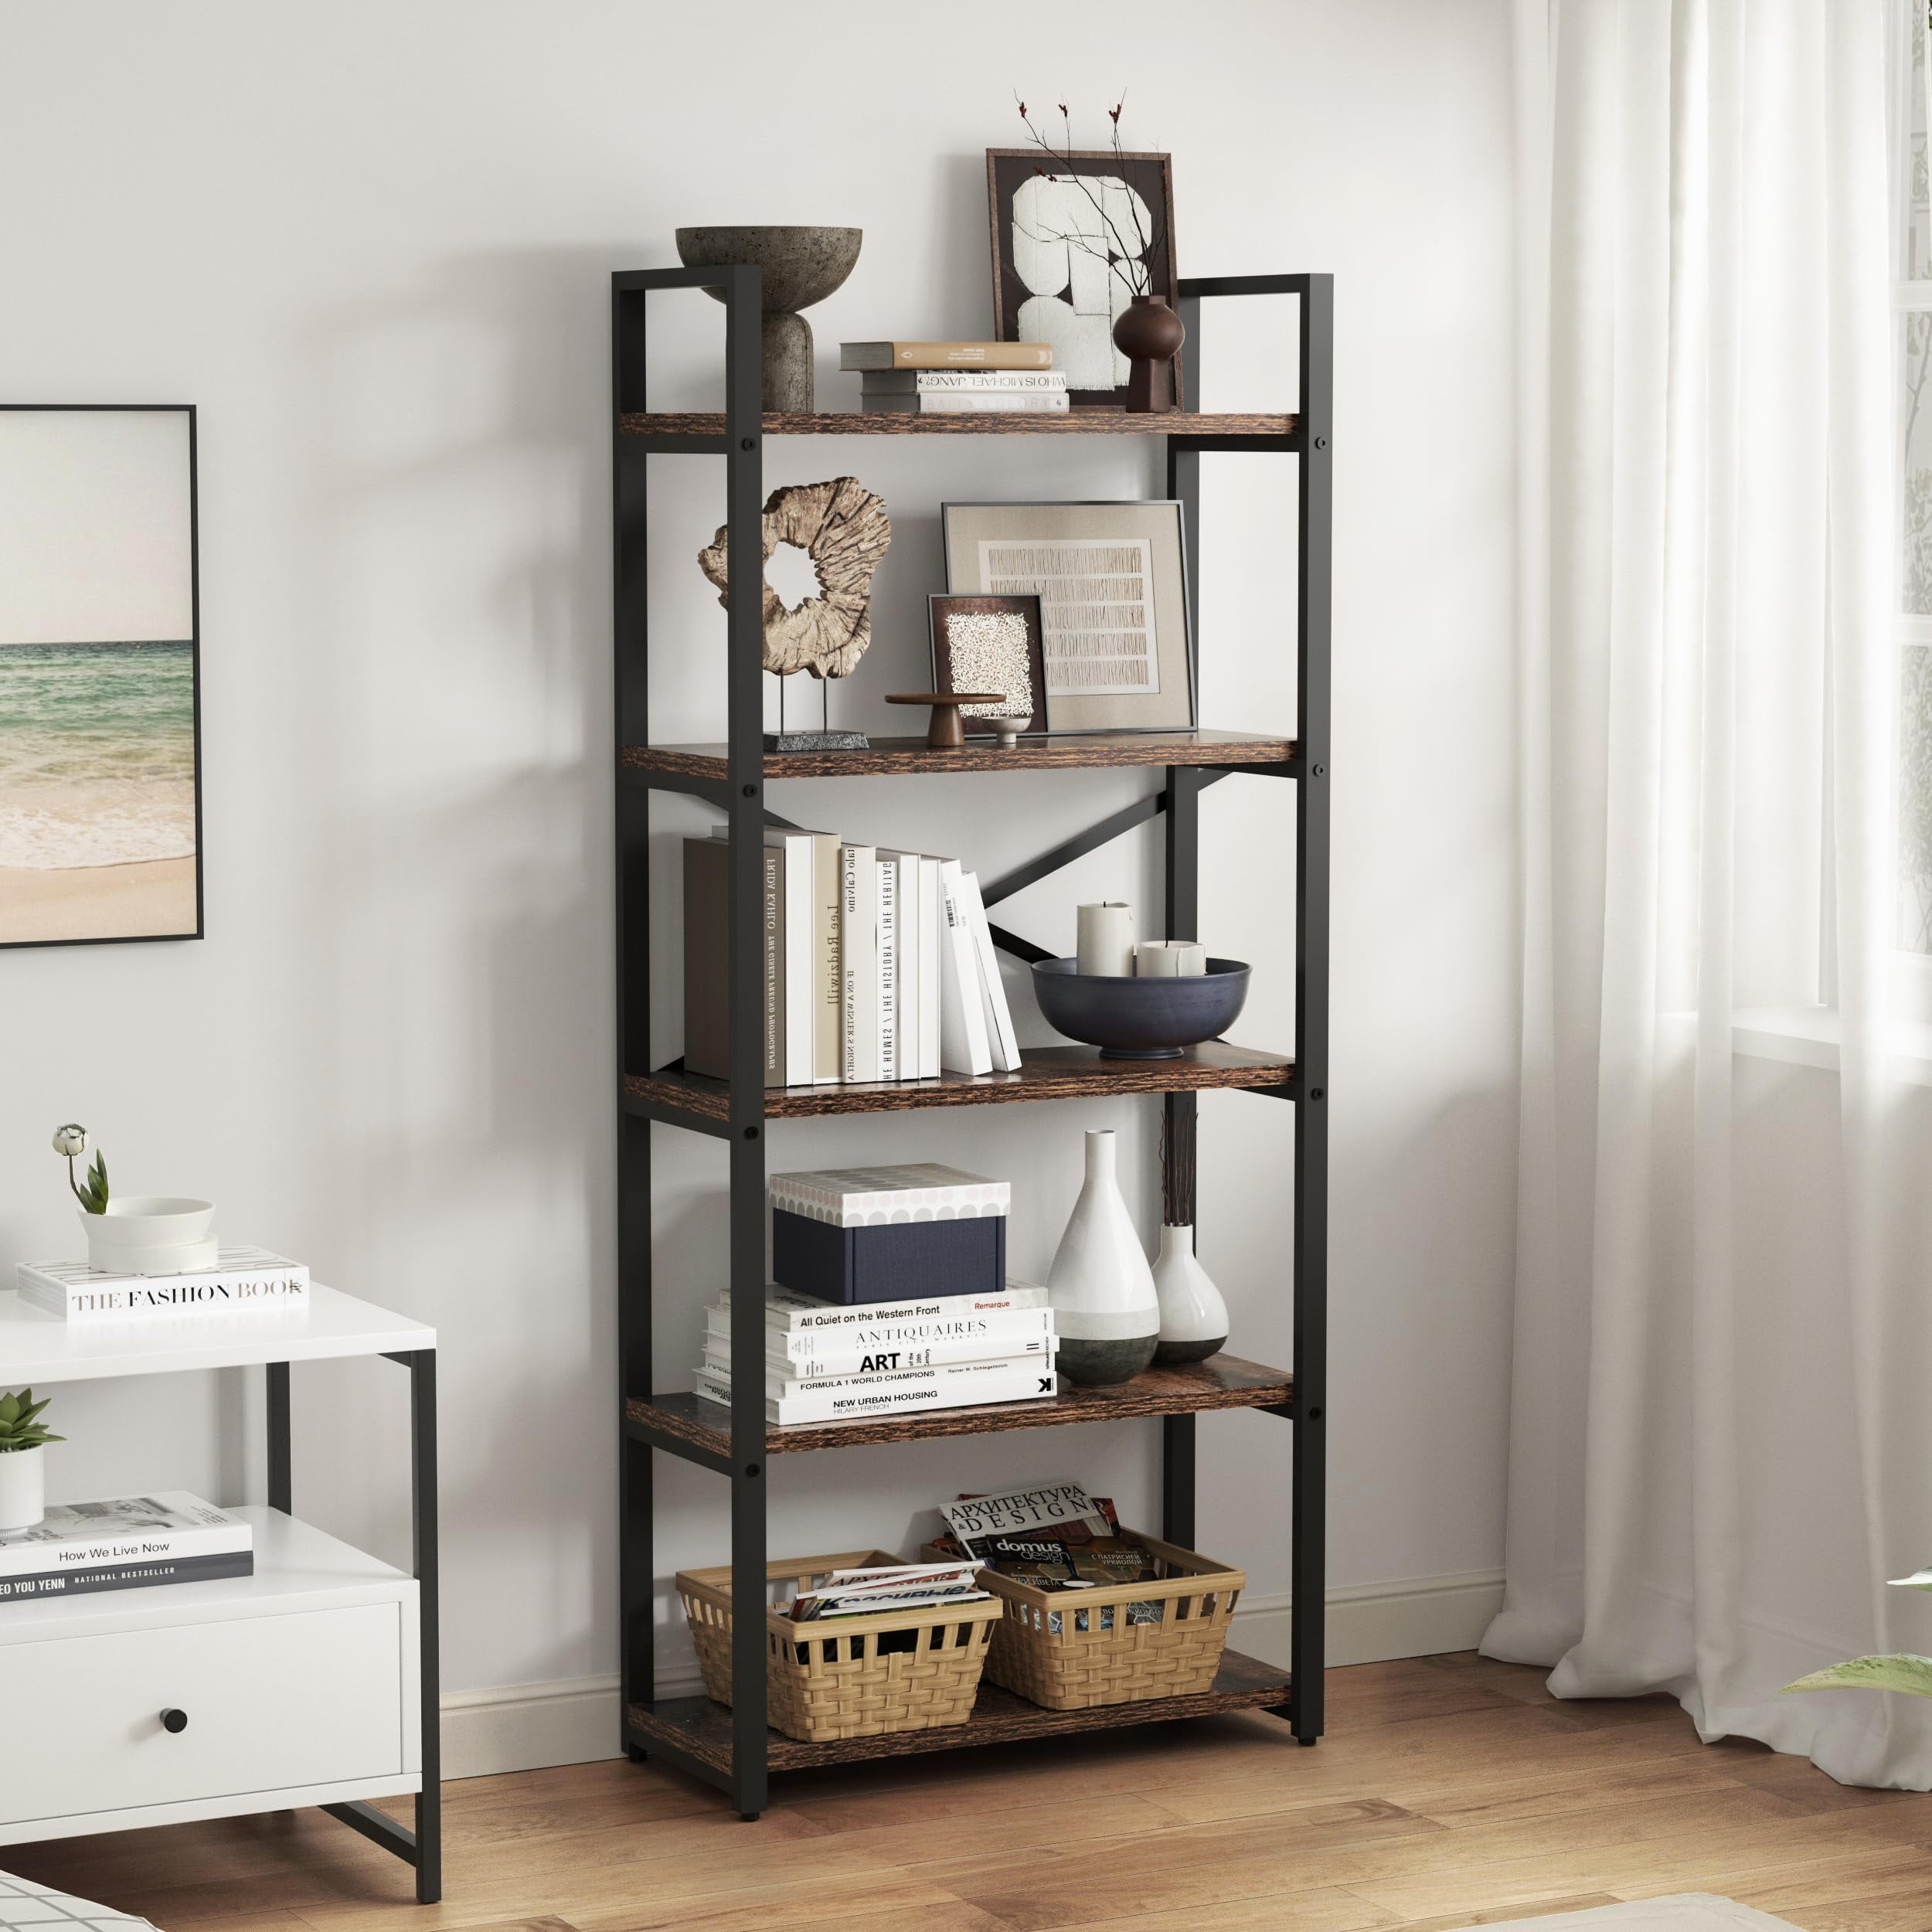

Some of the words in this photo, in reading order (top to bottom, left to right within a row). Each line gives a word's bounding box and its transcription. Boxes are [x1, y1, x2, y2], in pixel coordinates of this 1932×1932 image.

[926, 376, 967, 386] JANG?
[969, 376, 1023, 386] MICHAEL
[1026, 376, 1036, 386] IS
[1038, 376, 1066, 386] WHO
[72, 1293, 123, 1311] THE
[128, 1284, 231, 1308] FASHION
[237, 1278, 303, 1299] BOOK
[975, 1301, 1010, 1310] Remarque
[801, 1317, 812, 1327] All
[815, 1315, 841, 1326] Quiet
[844, 1315, 855, 1323] on
[859, 1312, 873, 1322] the
[876, 1308, 913, 1319] Western
[916, 1305, 940, 1315] Front
[855, 1319, 987, 1344] ANTIQUAIRES
[860, 1352, 900, 1372] ART
[801, 1379, 842, 1390] FORMULA
[851, 1375, 883, 1386] WORLD
[886, 1371, 935, 1383] CHAMPIONS
[833, 1397, 855, 1408] NEW
[858, 1394, 892, 1406] URBAN
[893, 1390, 937, 1403] HOUSING
[833, 1406, 859, 1415] HILARY
[860, 1403, 889, 1412] FRENCH
[951, 1485, 1087, 1520] АРХИТЕКТУРА
[964, 1498, 1089, 1532] DESIGN
[59, 1551, 86, 1562] How
[90, 1548, 110, 1558] We
[114, 1544, 138, 1556] Live
[143, 1543, 170, 1553] Now
[996, 1539, 1063, 1553] domus
[1021, 1550, 1070, 1564] design
[74, 1573, 116, 1583] NATIONAL
[121, 1567, 175, 1579] BESTSELLER
[0, 1583, 11, 1595] EO
[14, 1580, 36, 1593] YOU
[38, 1577, 66, 1590] YENN
